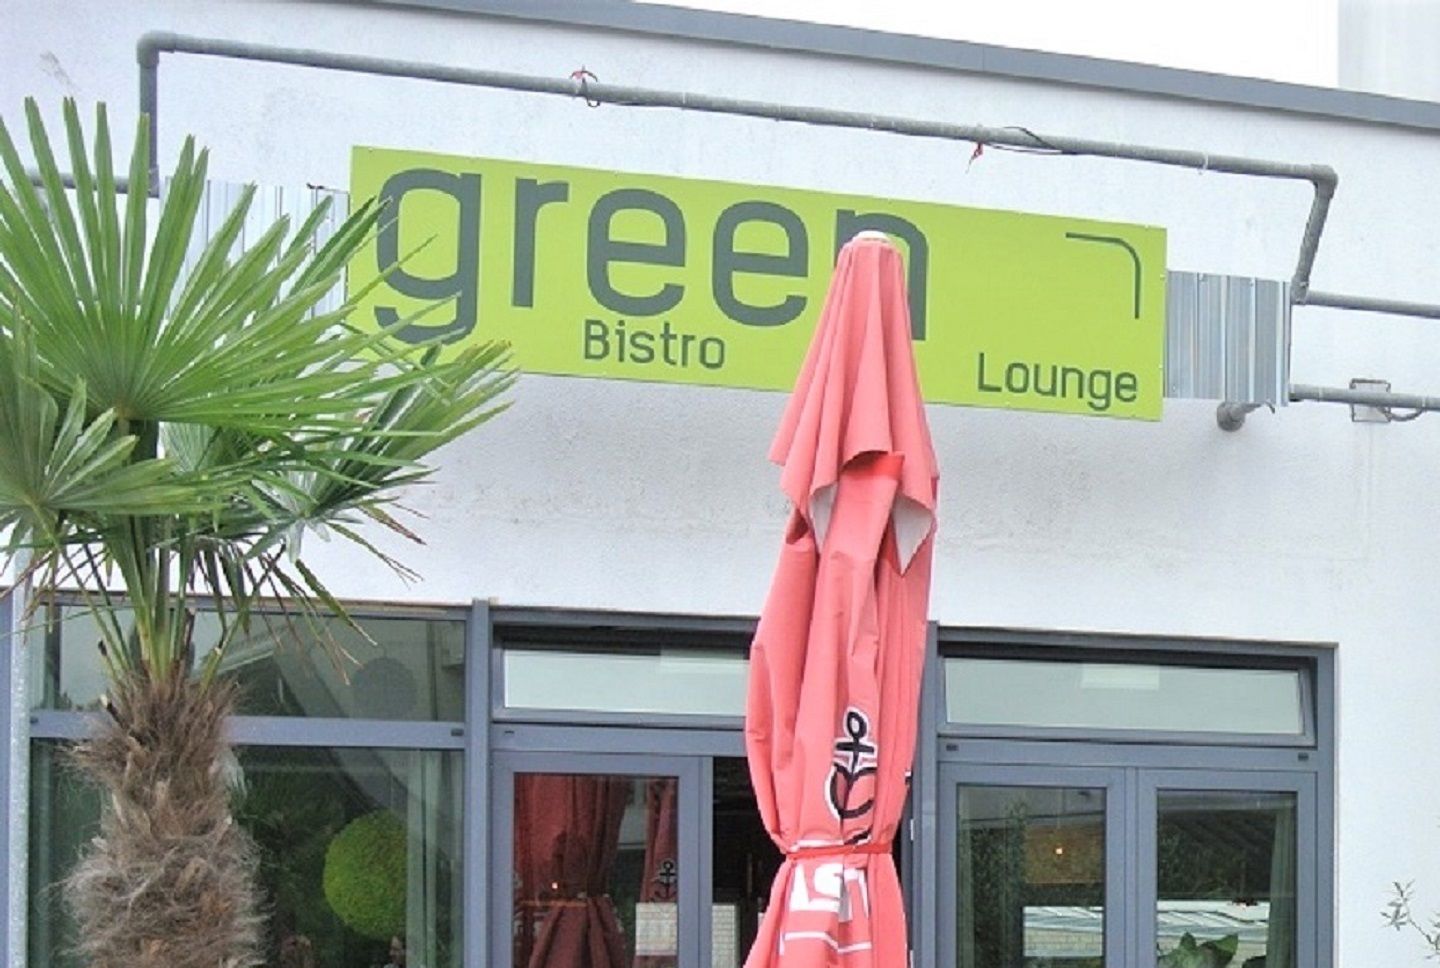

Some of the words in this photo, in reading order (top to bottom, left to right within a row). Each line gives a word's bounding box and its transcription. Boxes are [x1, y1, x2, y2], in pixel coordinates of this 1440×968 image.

[375, 168, 929, 345] green
[583, 319, 726, 369] Bistro
[977, 352, 1138, 411] Lounge
